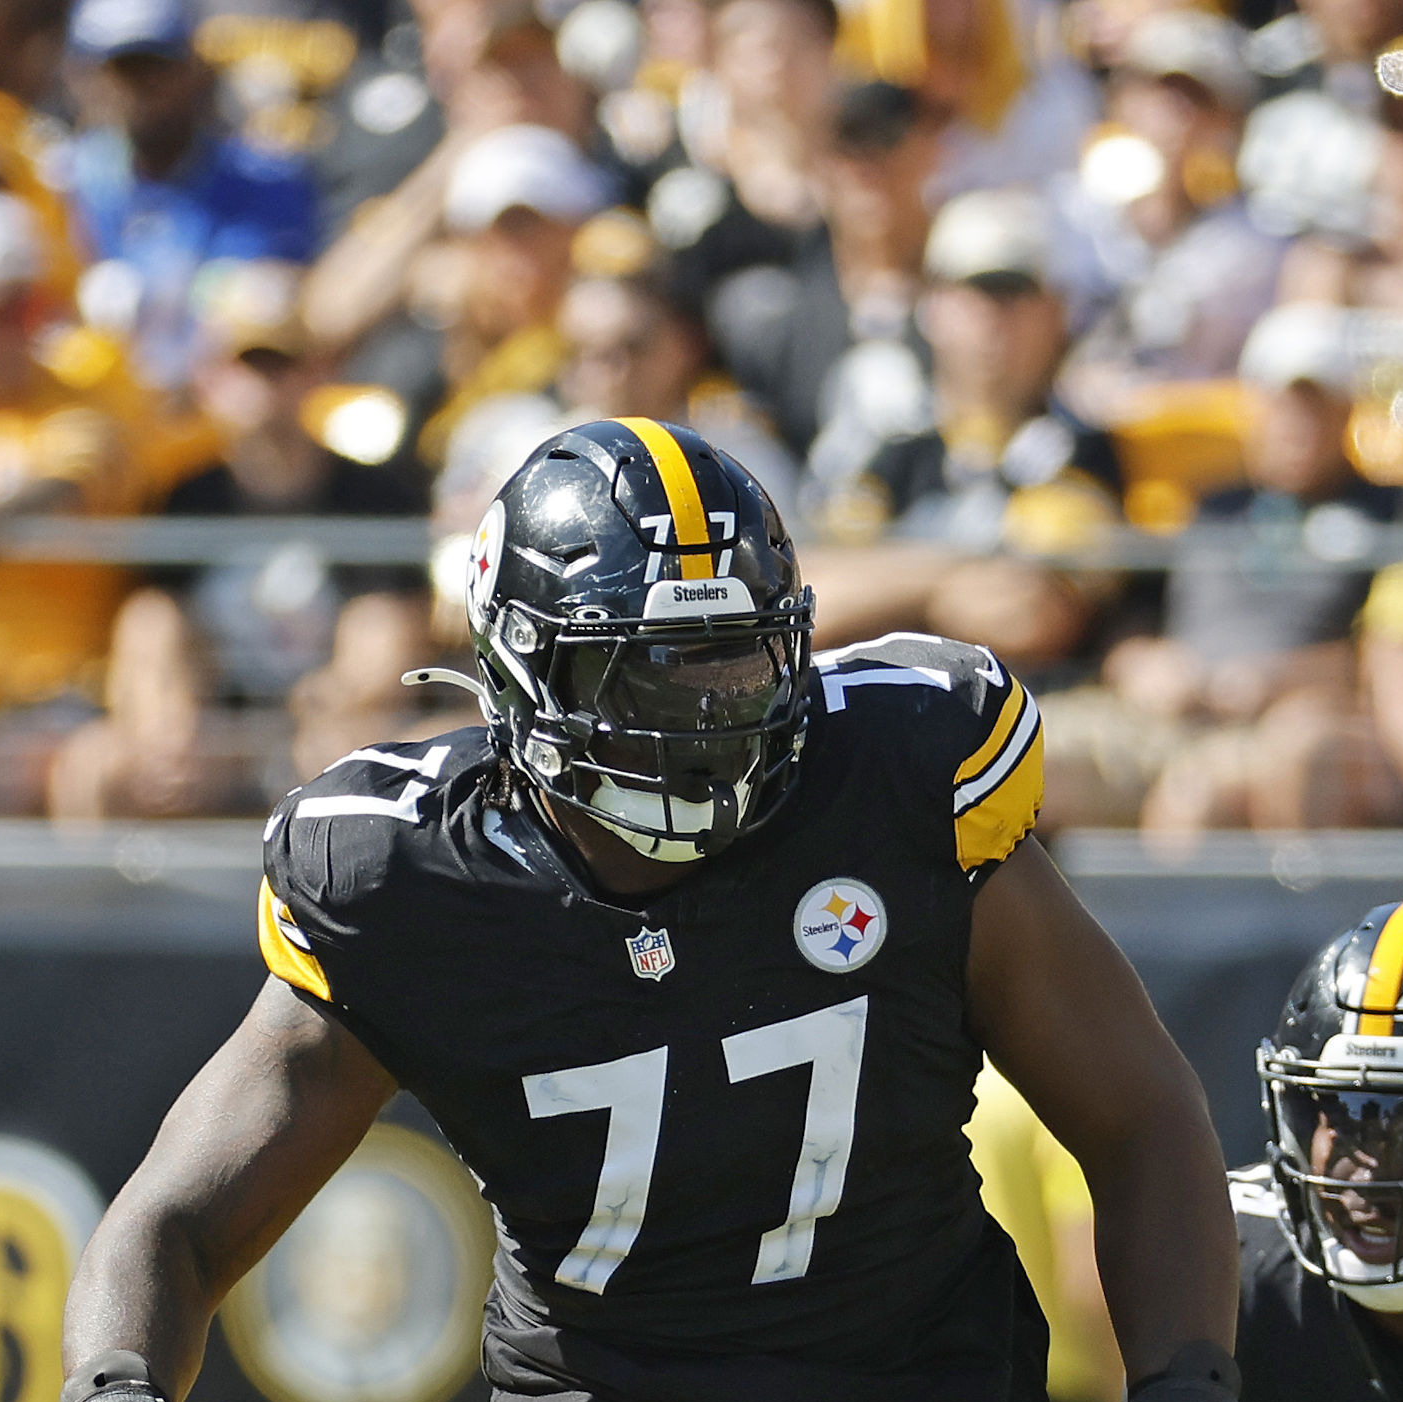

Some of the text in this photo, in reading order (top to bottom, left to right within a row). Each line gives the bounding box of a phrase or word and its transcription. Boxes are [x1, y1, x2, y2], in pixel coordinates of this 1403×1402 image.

[639, 511, 736, 584] 77
[673, 584, 728, 602] Steelers
[802, 922, 840, 937] Steelers
[637, 950, 669, 972] NFL
[521, 994, 869, 1296] 77
